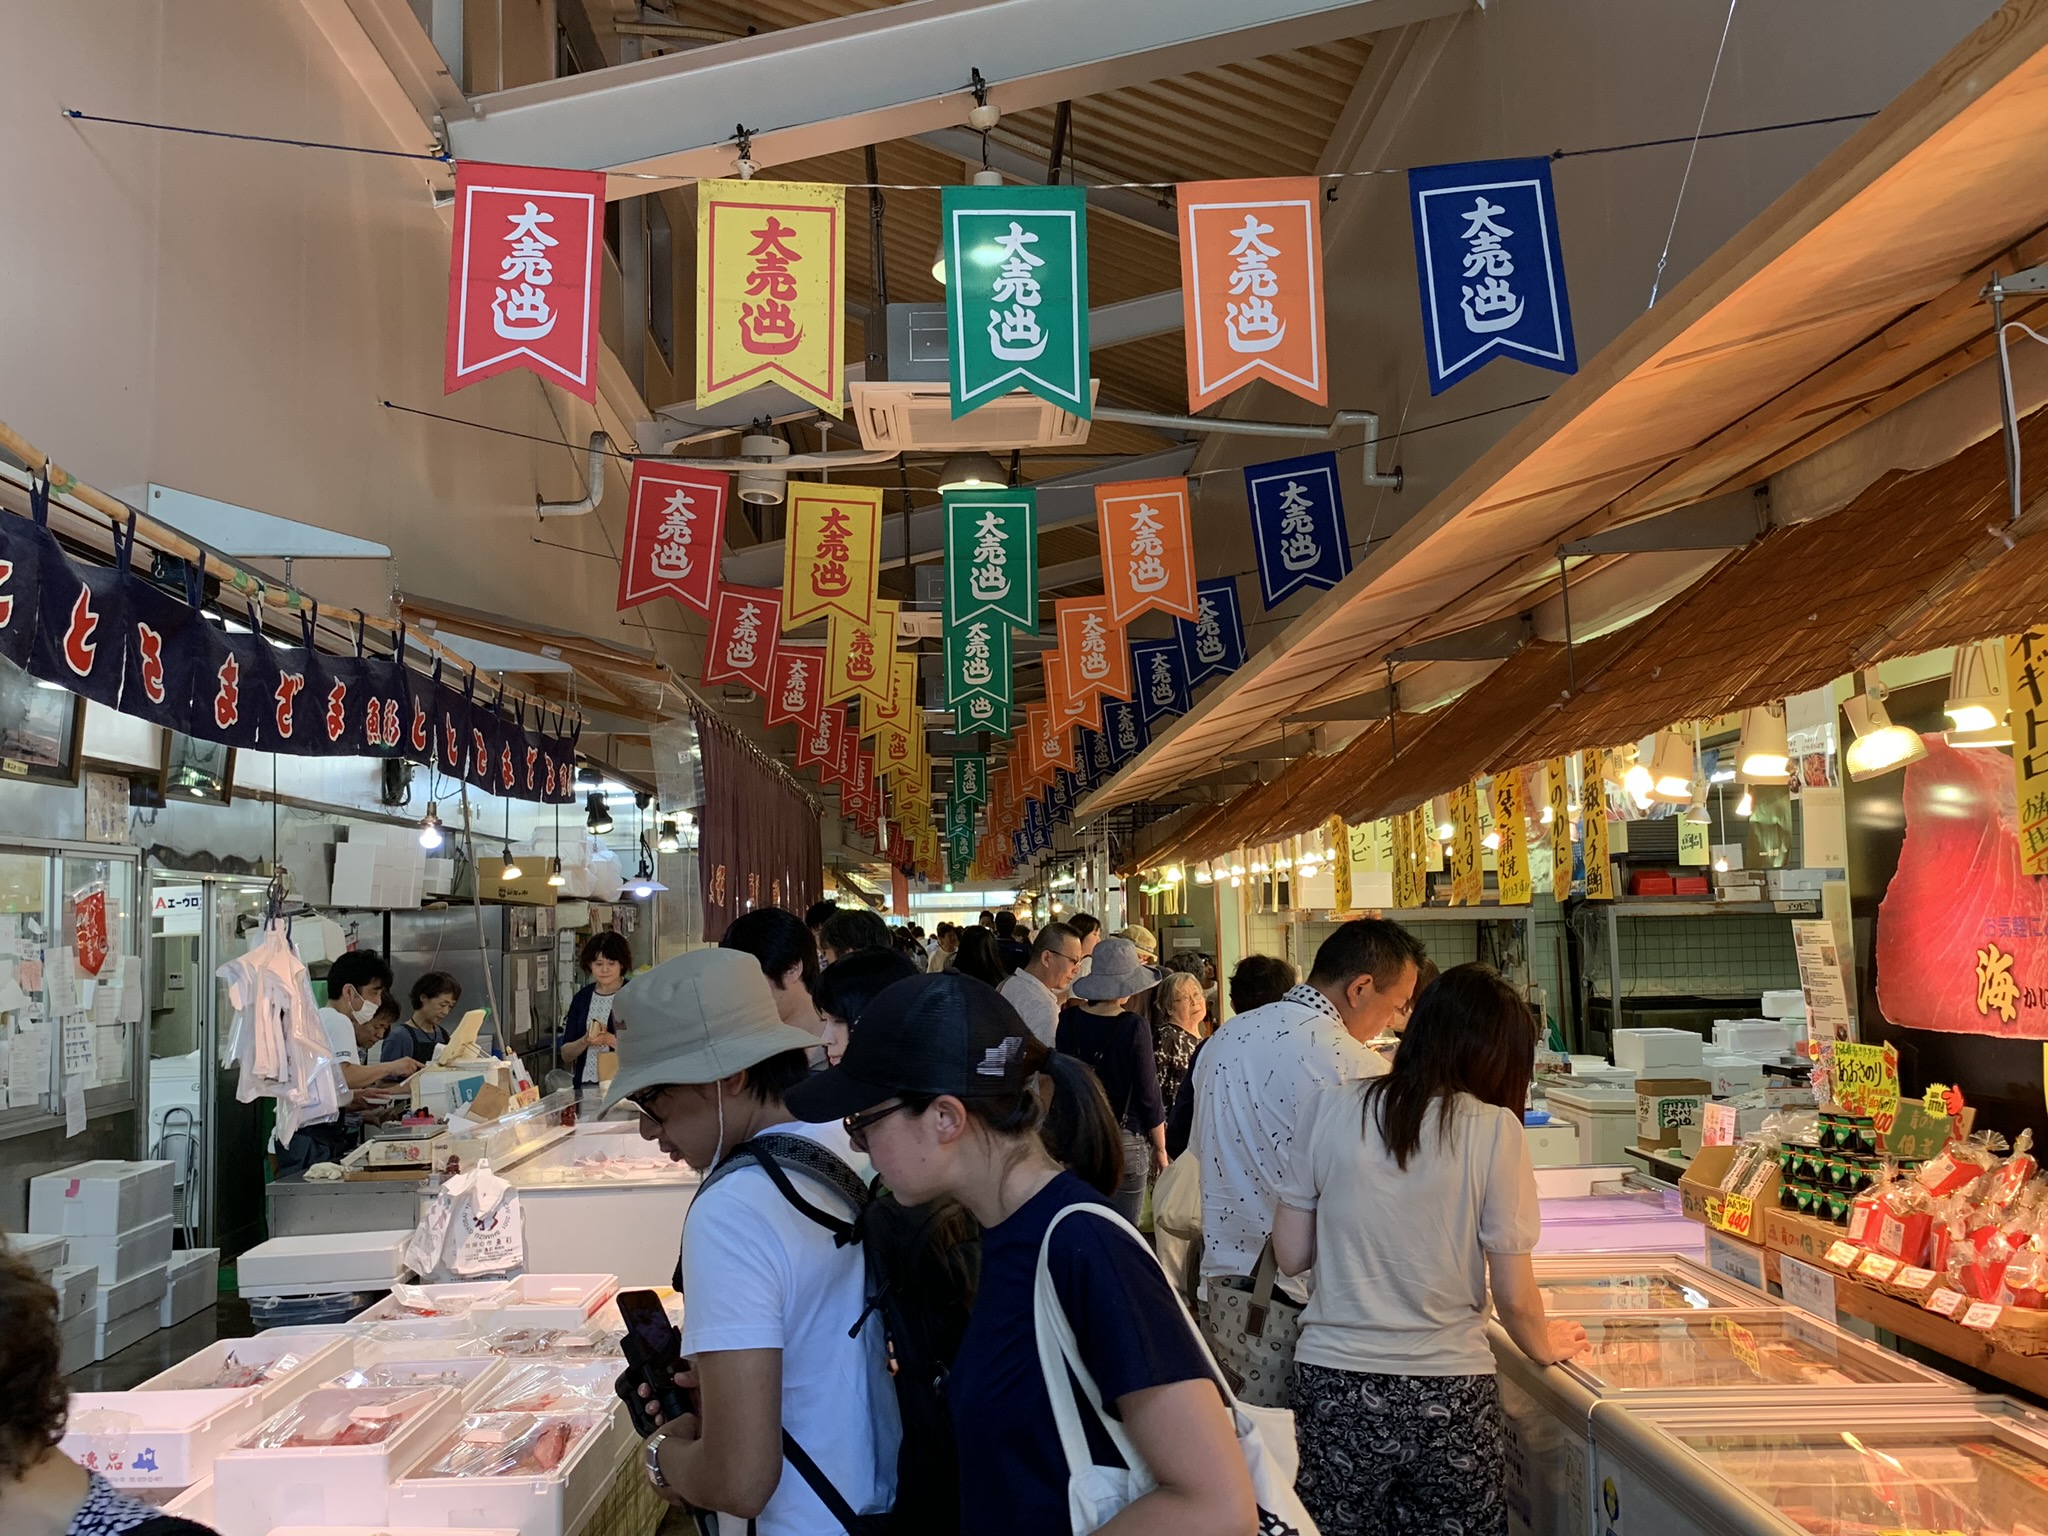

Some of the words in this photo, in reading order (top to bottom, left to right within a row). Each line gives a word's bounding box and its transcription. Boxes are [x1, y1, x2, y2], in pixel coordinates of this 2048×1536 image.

[492, 200, 560, 341] 大売出
[738, 215, 804, 356] 大売出
[986, 221, 1050, 362] 大売出
[1224, 213, 1287, 354] 大売出
[1461, 196, 1525, 335] 大売出
[650, 488, 698, 579] 大売出
[811, 507, 854, 598] 大売出
[969, 510, 1012, 600] 大売出
[1128, 503, 1171, 593] 大売出
[1278, 480, 1322, 571] 大売出
[726, 602, 763, 669] 大売出
[962, 622, 994, 686] 大売出
[1079, 613, 1111, 680] 大売出
[1150, 652, 1176, 706] 大売出
[782, 658, 809, 713] 大売出
[1116, 705, 1139, 750] 大売出
[962, 761, 979, 795] 大売出
[1976, 943, 2020, 1023] 海
[1727, 1210, 1750, 1232] 440
